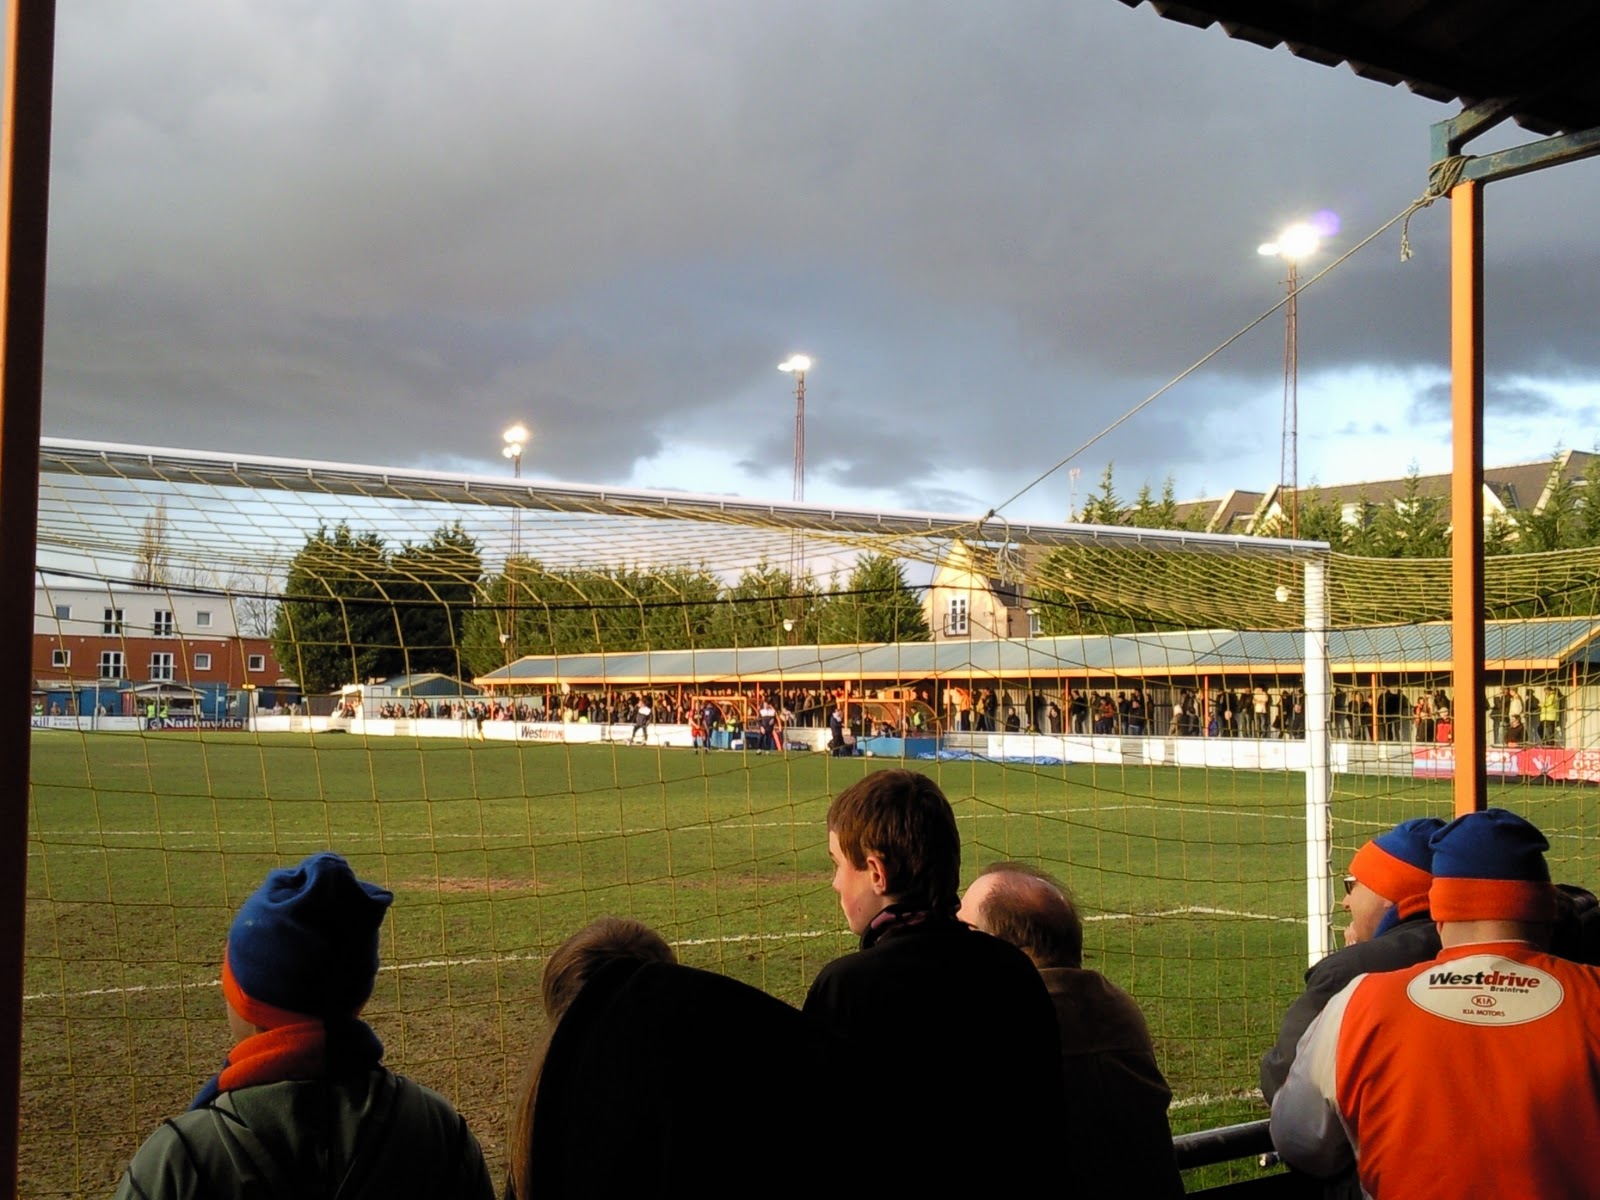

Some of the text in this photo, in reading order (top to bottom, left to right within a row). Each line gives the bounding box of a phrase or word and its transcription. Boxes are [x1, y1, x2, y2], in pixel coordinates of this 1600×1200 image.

[163, 717, 242, 728] Nationwide
[521, 725, 564, 740] Westdrive
[1429, 971, 1540, 988] Westdrive
[1490, 986, 1529, 994] Braintree
[1476, 997, 1493, 1005] KIA
[1476, 1009, 1506, 1017] MOTORS
